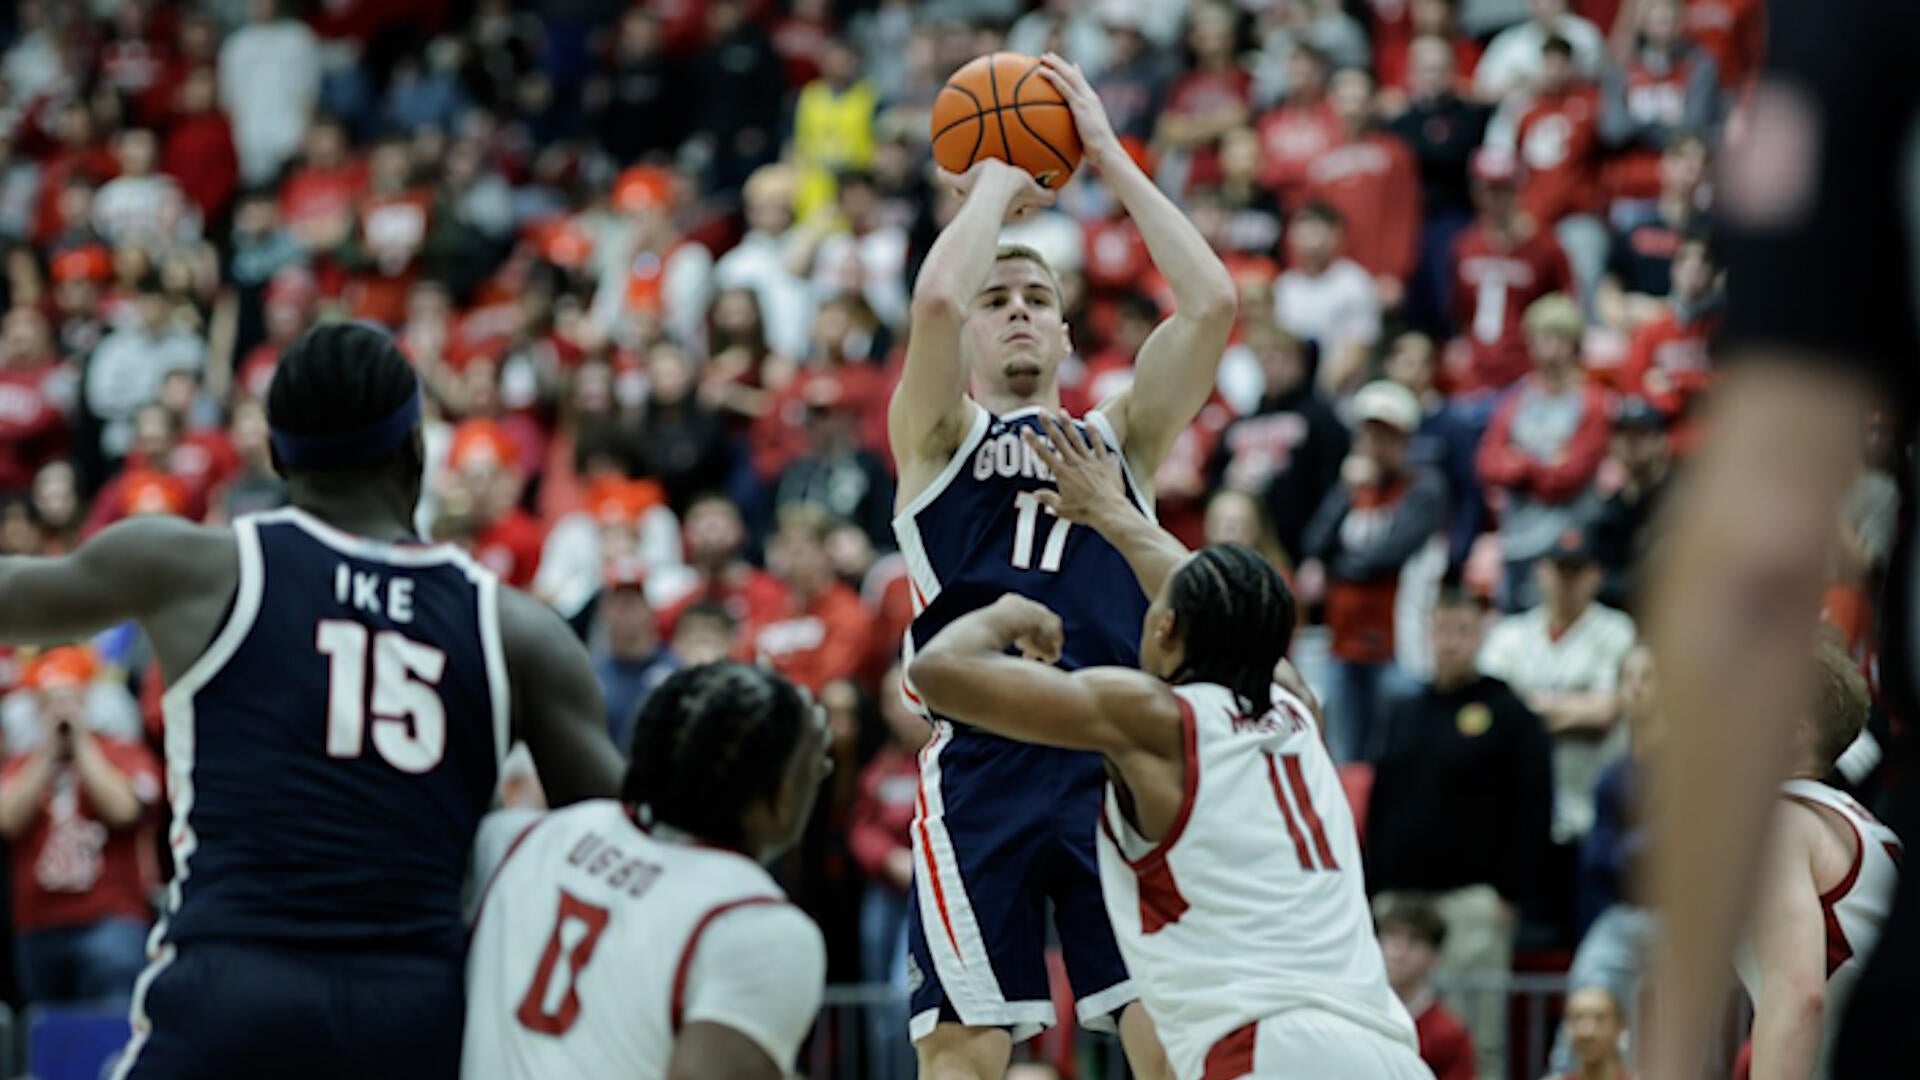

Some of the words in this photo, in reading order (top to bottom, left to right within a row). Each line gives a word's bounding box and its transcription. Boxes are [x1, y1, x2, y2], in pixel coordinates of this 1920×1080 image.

[1011, 490, 1072, 573] 17
[334, 560, 416, 624] IKE
[315, 617, 448, 775] 15
[1261, 750, 1341, 872] 11
